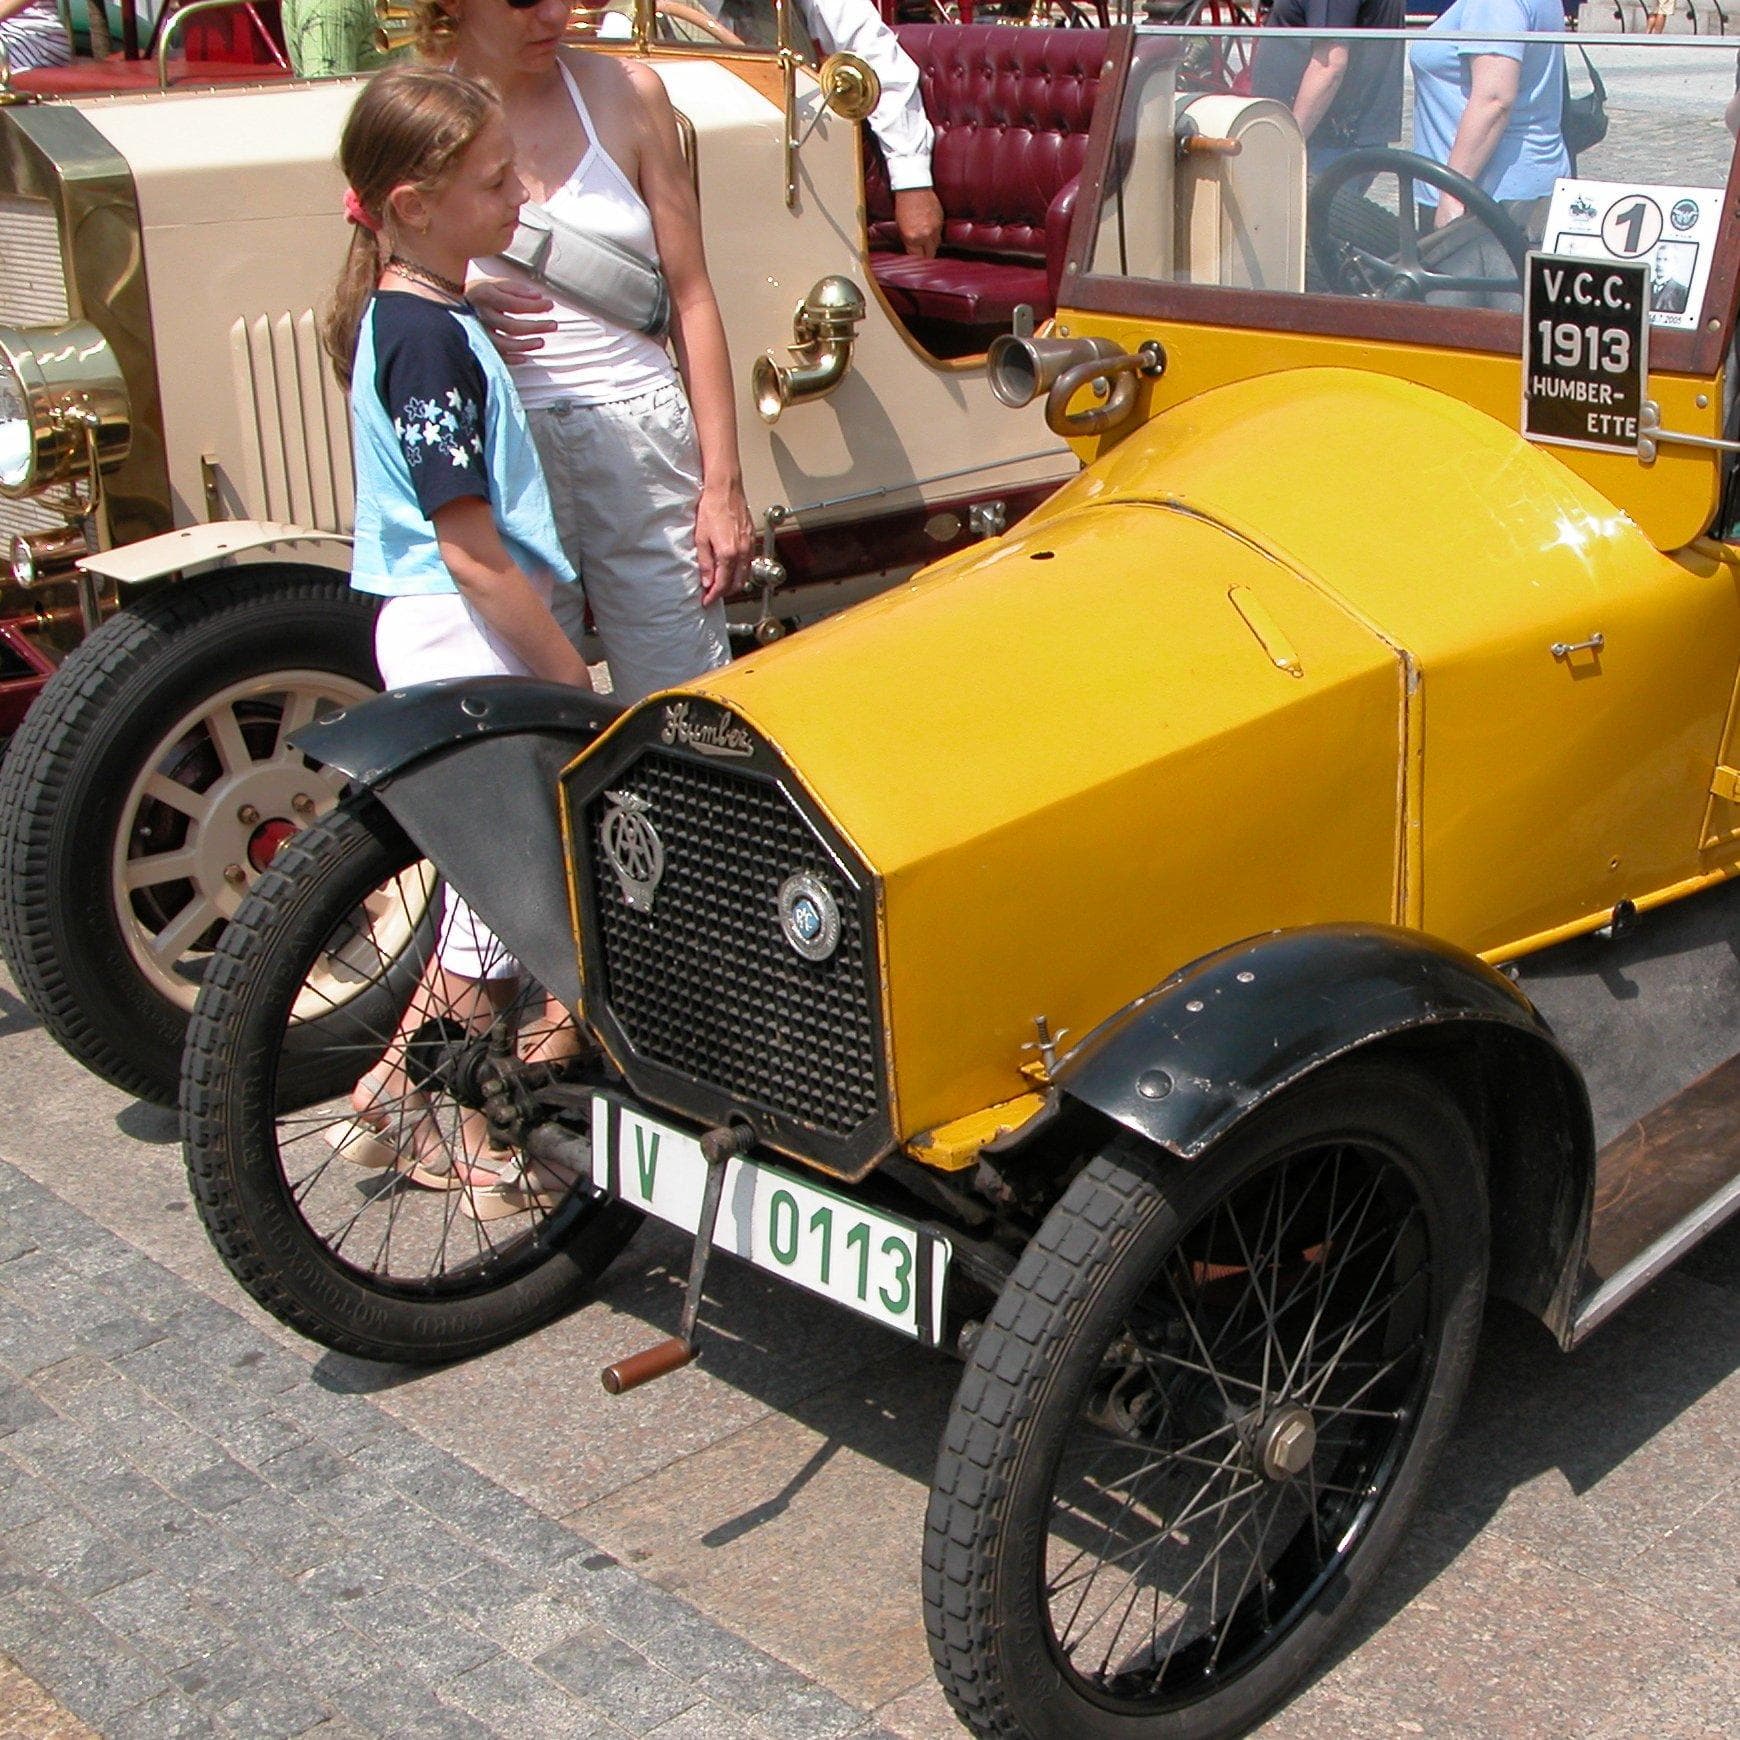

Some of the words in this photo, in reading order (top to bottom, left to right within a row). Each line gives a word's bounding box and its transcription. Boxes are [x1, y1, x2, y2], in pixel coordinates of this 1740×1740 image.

[1615, 203, 1647, 253] 1
[1543, 269, 1632, 311] V.C.C.
[1538, 320, 1631, 374] 1913
[1533, 375, 1625, 405] HUMBER-
[1587, 413, 1638, 438] ETTE
[661, 702, 754, 757] Humber
[635, 1124, 660, 1203] V
[769, 1189, 913, 1315] 0113
